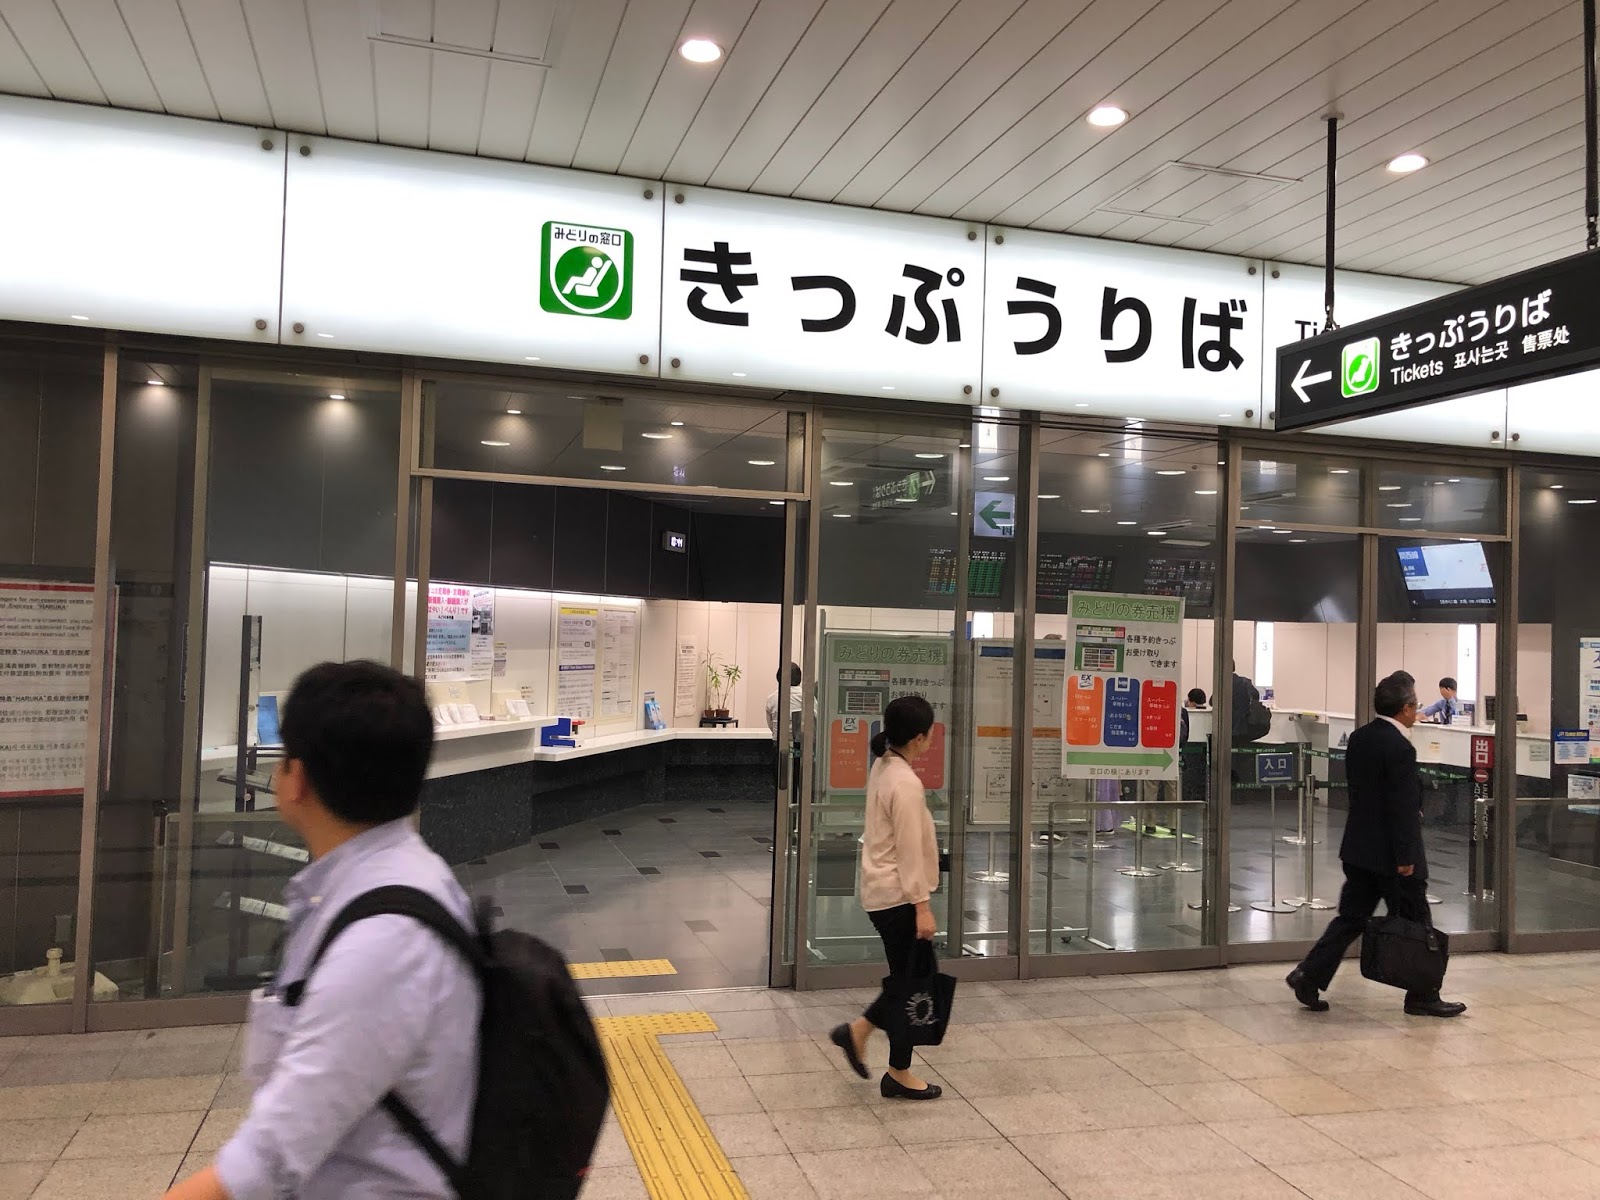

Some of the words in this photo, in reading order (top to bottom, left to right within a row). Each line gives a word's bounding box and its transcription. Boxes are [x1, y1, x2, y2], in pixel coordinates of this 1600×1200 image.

[554, 227, 622, 247] みどりの窓口
[680, 242, 1247, 372] きっぷうりば
[1389, 288, 1552, 361] きっぷうりば
[1521, 325, 1571, 355] 售票处
[1453, 344, 1509, 370] 표사는곳
[1390, 359, 1444, 386] Tickets
[1076, 600, 1175, 620] みどりの券売機
[1126, 634, 1177, 645] 各種予約きっぷ
[839, 645, 943, 662] みどりの券売機
[1125, 648, 1160, 657] お受け取り
[1149, 660, 1178, 668] できます
[1475, 739, 1489, 764] 出口
[1089, 767, 1151, 776] 窓口の横にあります
[1264, 758, 1287, 769] 入口
